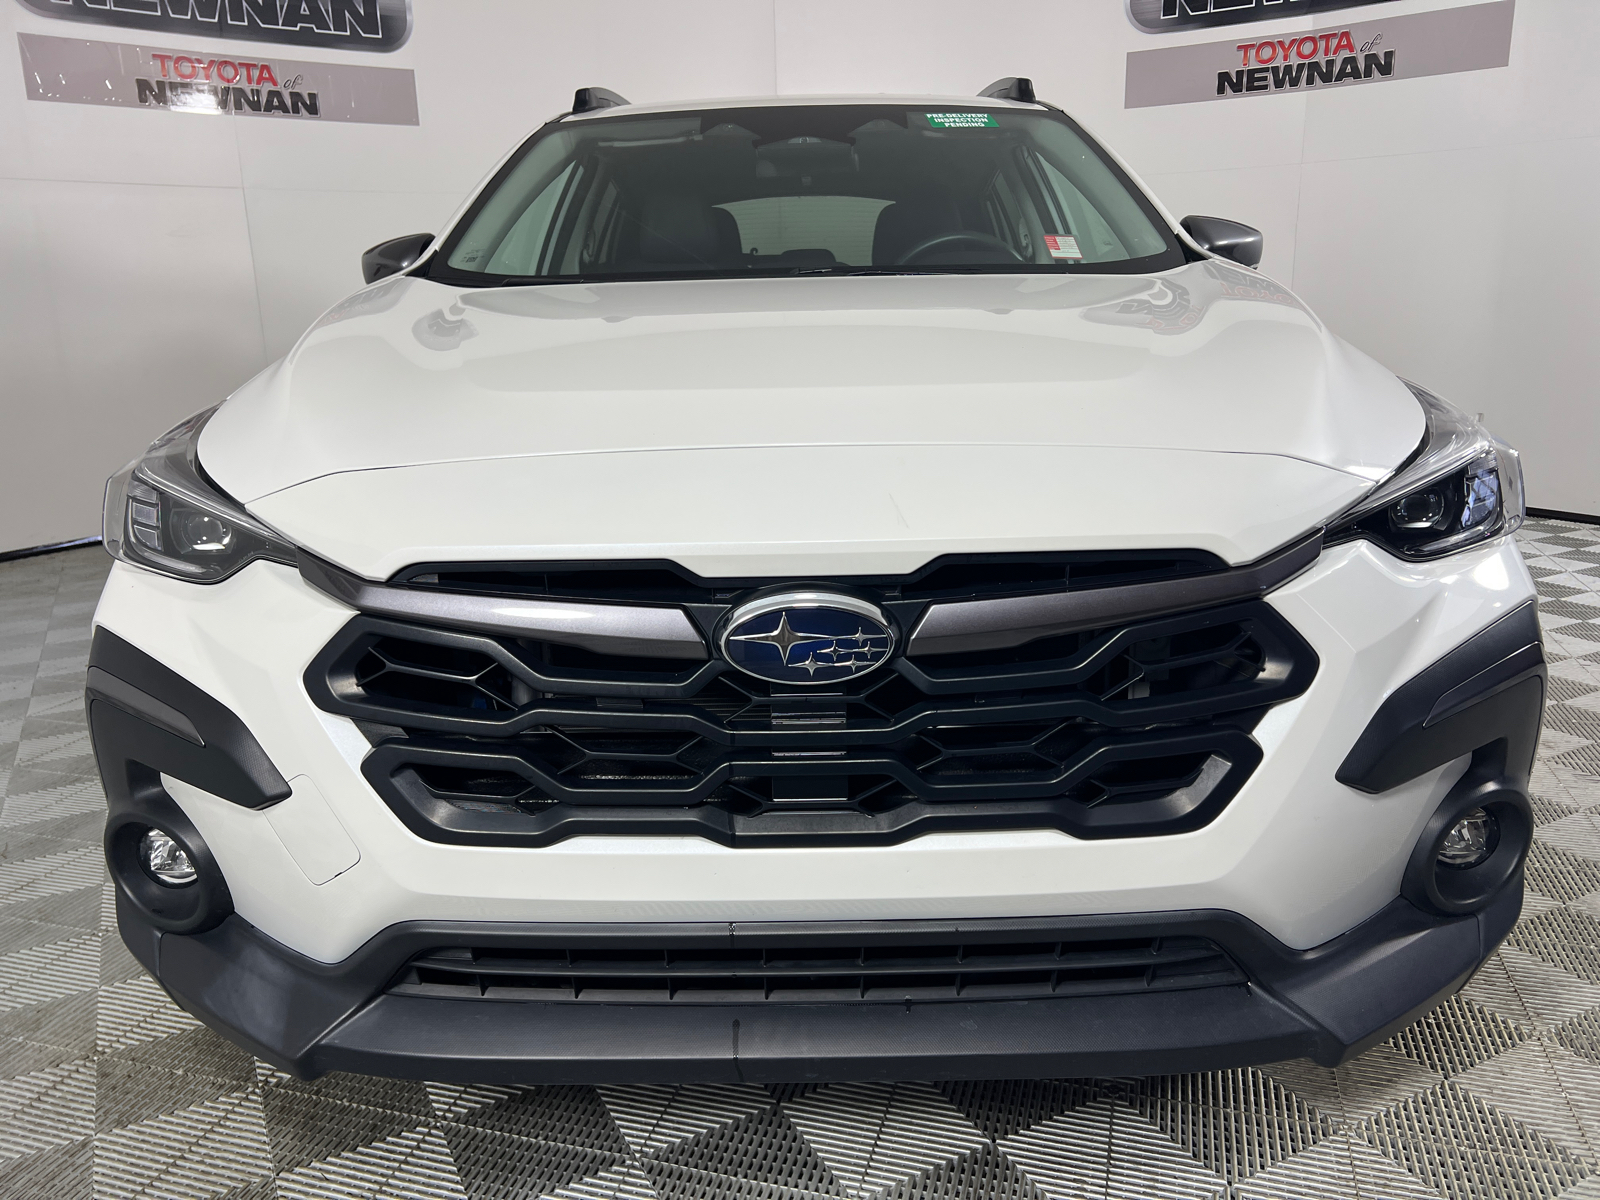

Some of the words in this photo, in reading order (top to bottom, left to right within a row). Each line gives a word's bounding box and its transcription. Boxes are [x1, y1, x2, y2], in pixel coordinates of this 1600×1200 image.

[48, 0, 382, 38] NAN
[1237, 30, 1355, 67] TOYOTA
[1359, 33, 1382, 54] of
[151, 53, 279, 87] TOYOTA
[283, 74, 303, 90] of
[1216, 49, 1395, 96] NEWNAN
